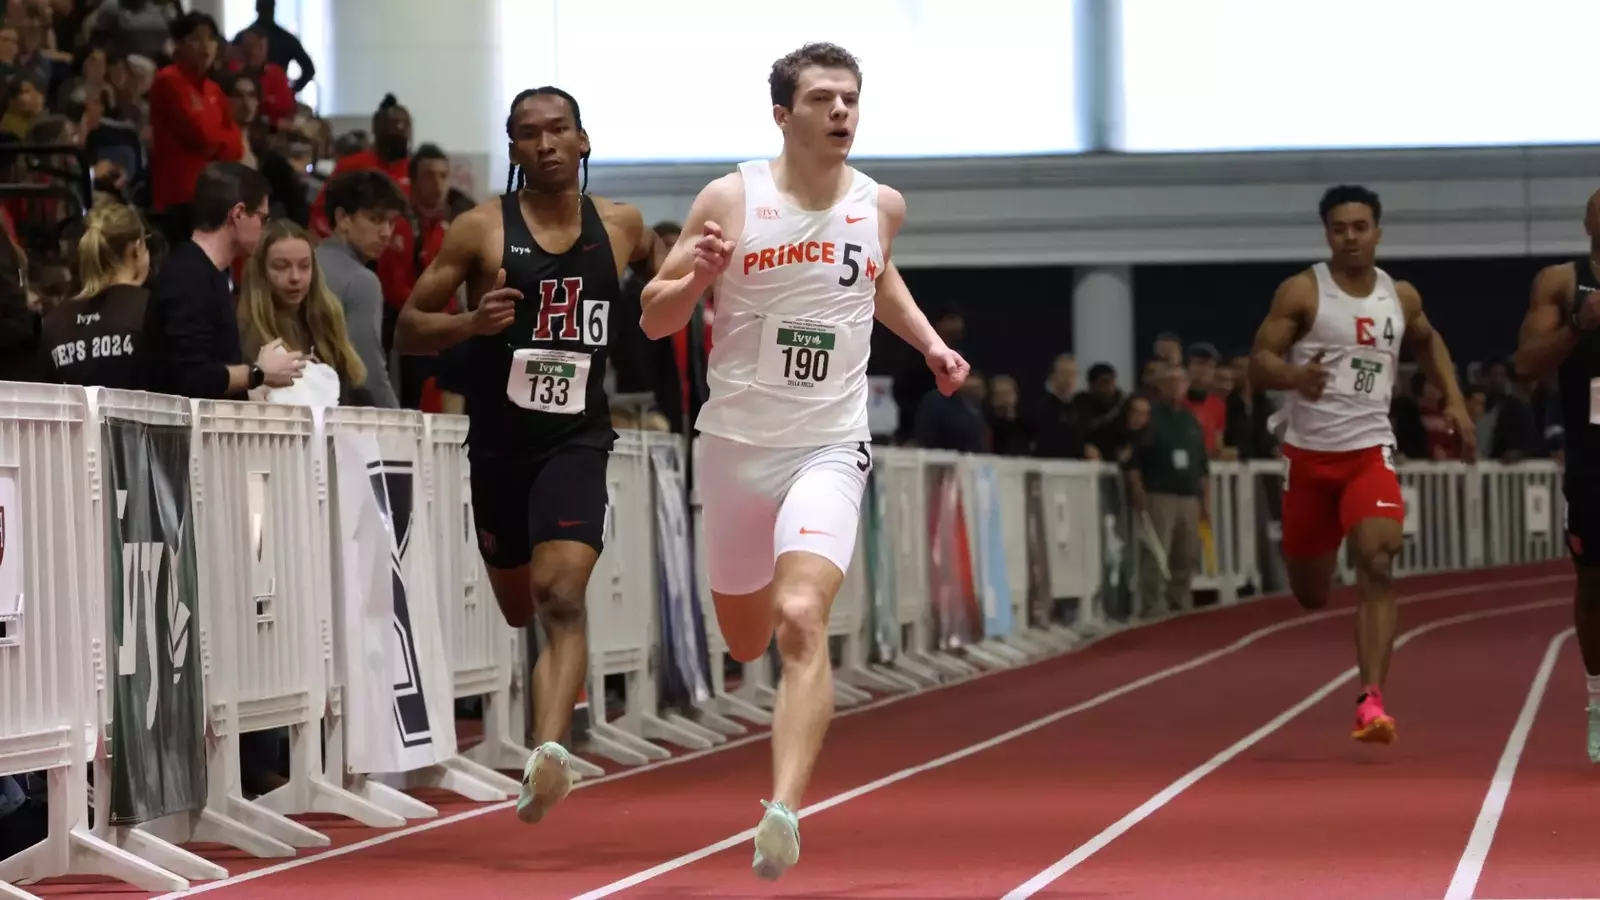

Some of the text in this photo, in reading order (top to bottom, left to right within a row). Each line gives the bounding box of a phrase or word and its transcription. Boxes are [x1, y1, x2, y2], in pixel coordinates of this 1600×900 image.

[510, 245, 524, 255] Ivy
[743, 241, 877, 281] PRINCEN
[838, 243, 862, 287] 5
[76, 313, 93, 325] Ivy
[532, 277, 583, 341] H
[588, 302, 604, 343] 6
[792, 331, 811, 346] Ivy
[1383, 317, 1395, 346] 4
[92, 334, 134, 359] 2024
[539, 362, 554, 374] Ivy
[782, 347, 829, 382] 190
[529, 375, 570, 406] 133
[1354, 370, 1375, 393] 80
